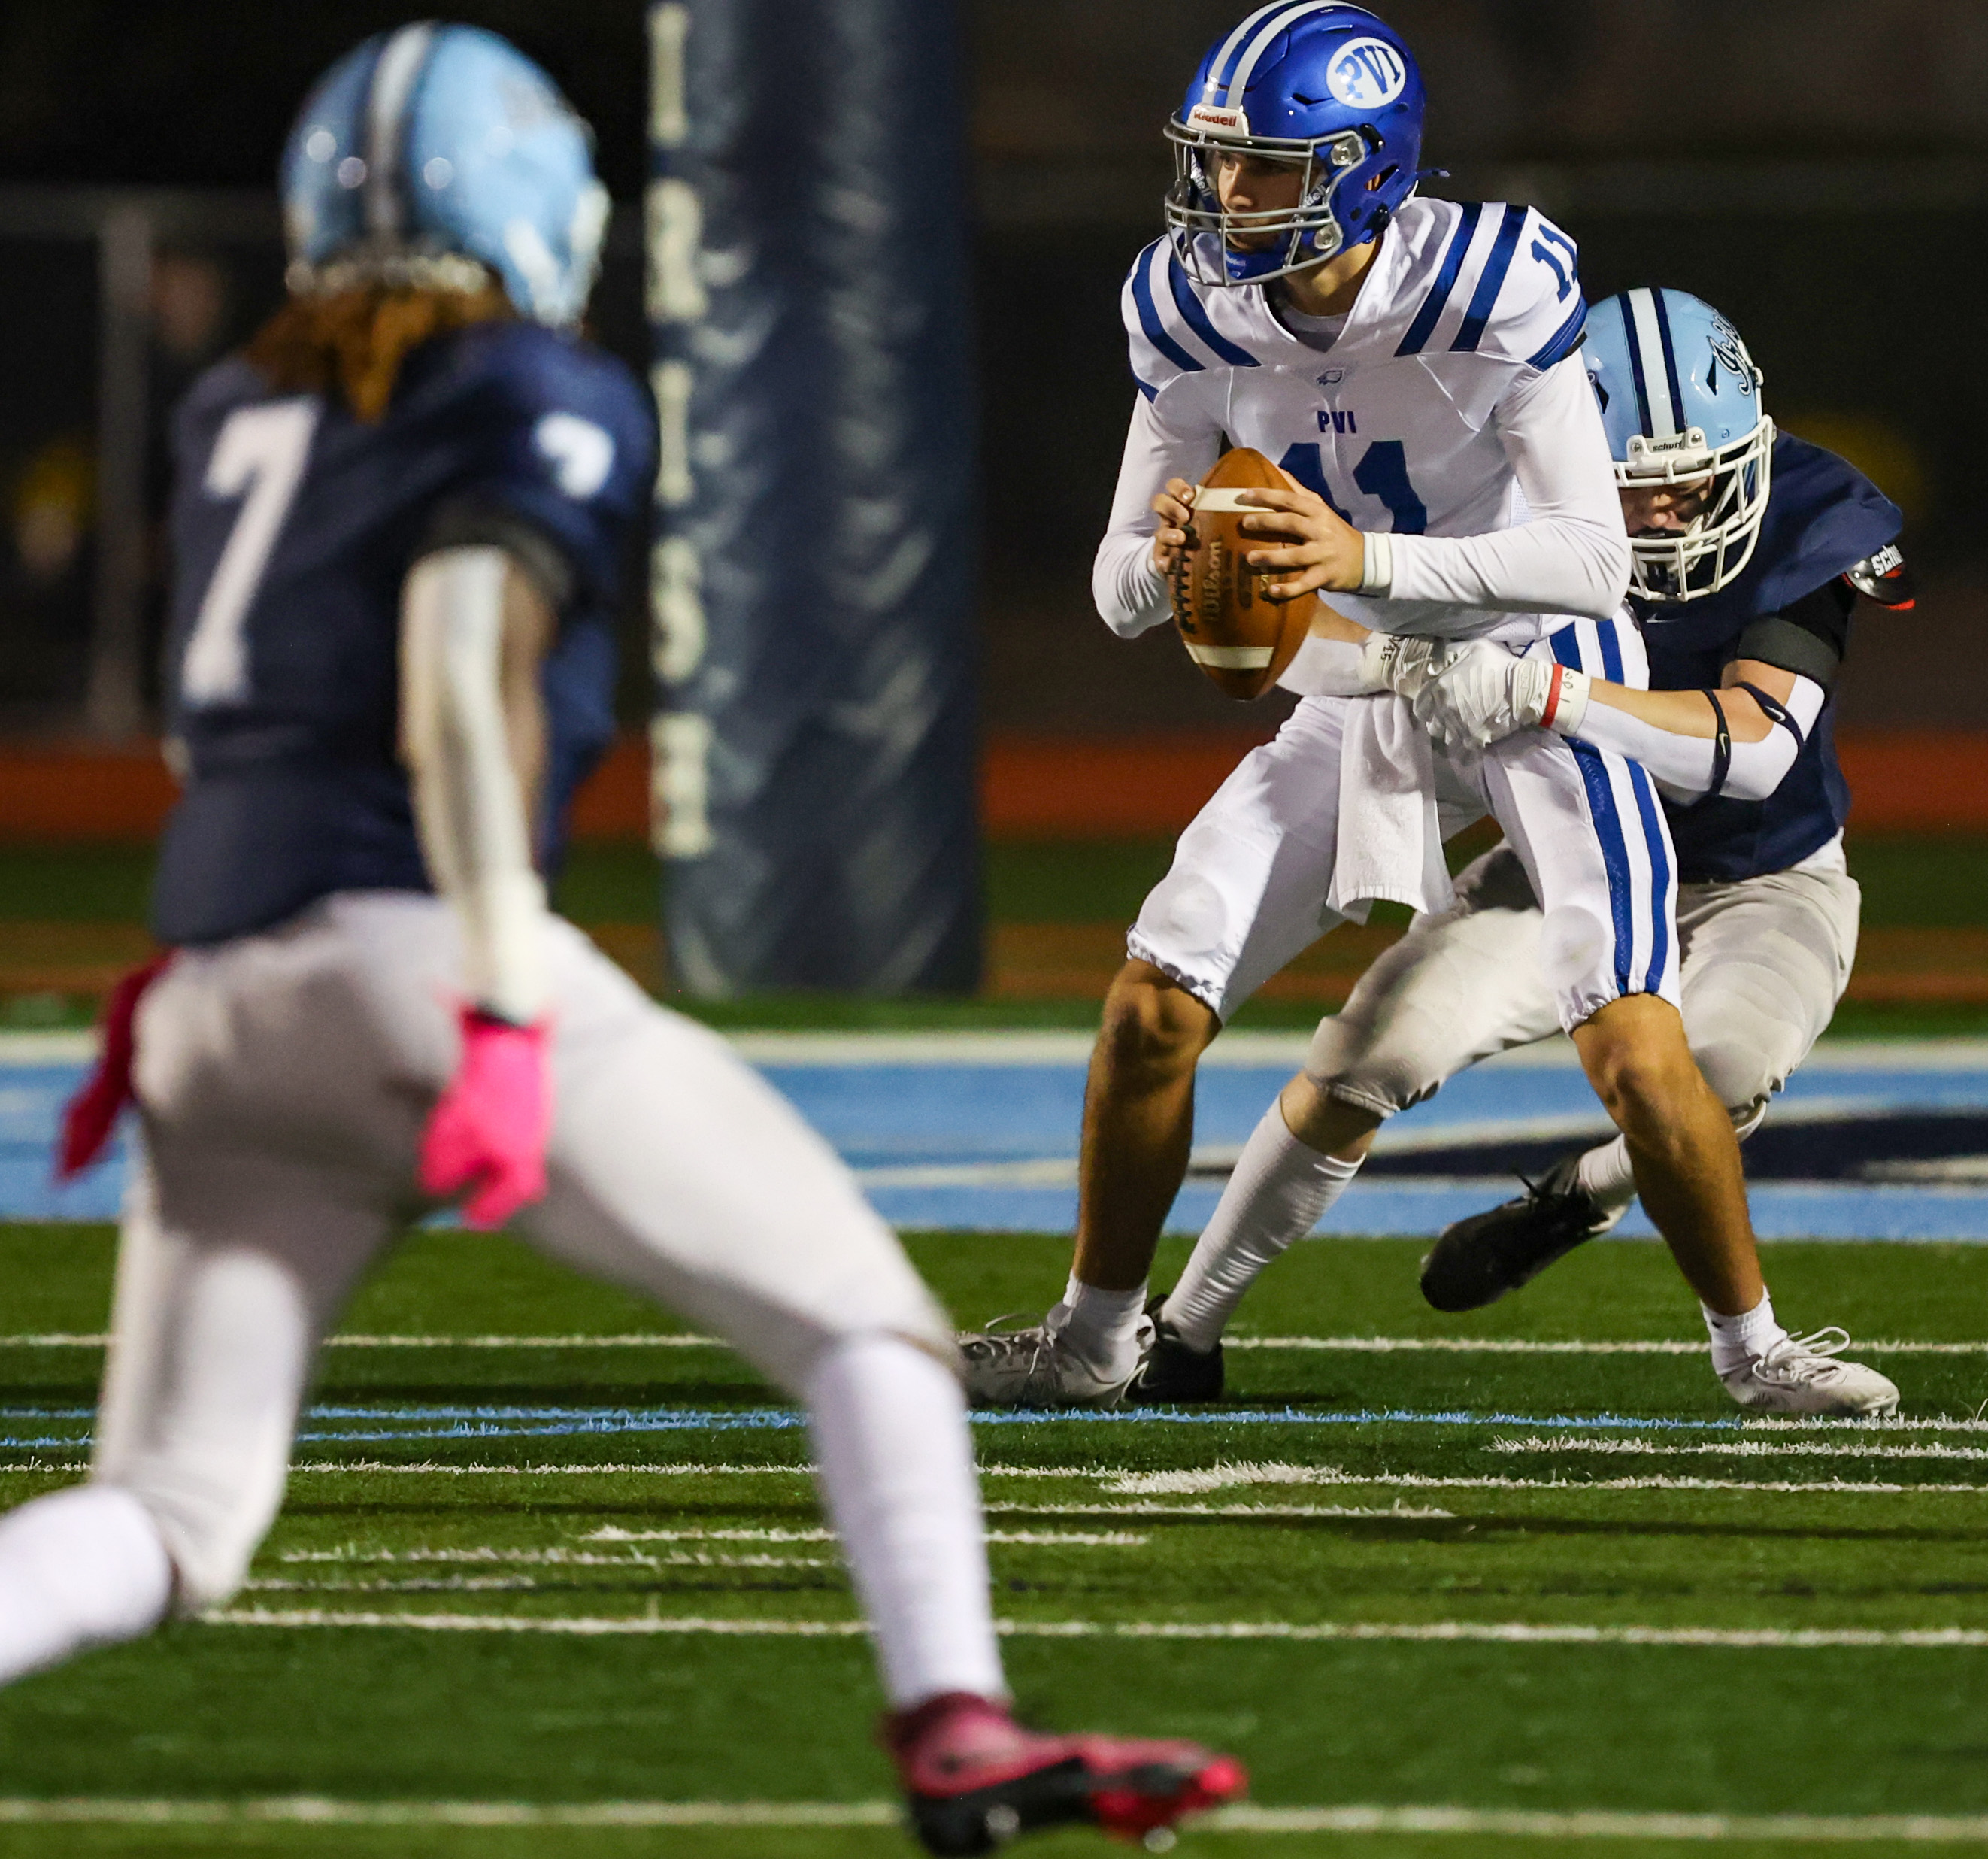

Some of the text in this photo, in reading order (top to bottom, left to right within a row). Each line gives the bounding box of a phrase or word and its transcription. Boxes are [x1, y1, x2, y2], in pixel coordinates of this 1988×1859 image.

[1335, 45, 1401, 99] PVI
[1531, 223, 1578, 304] 11
[1317, 410, 1356, 434] PVI
[182, 396, 322, 705] 7
